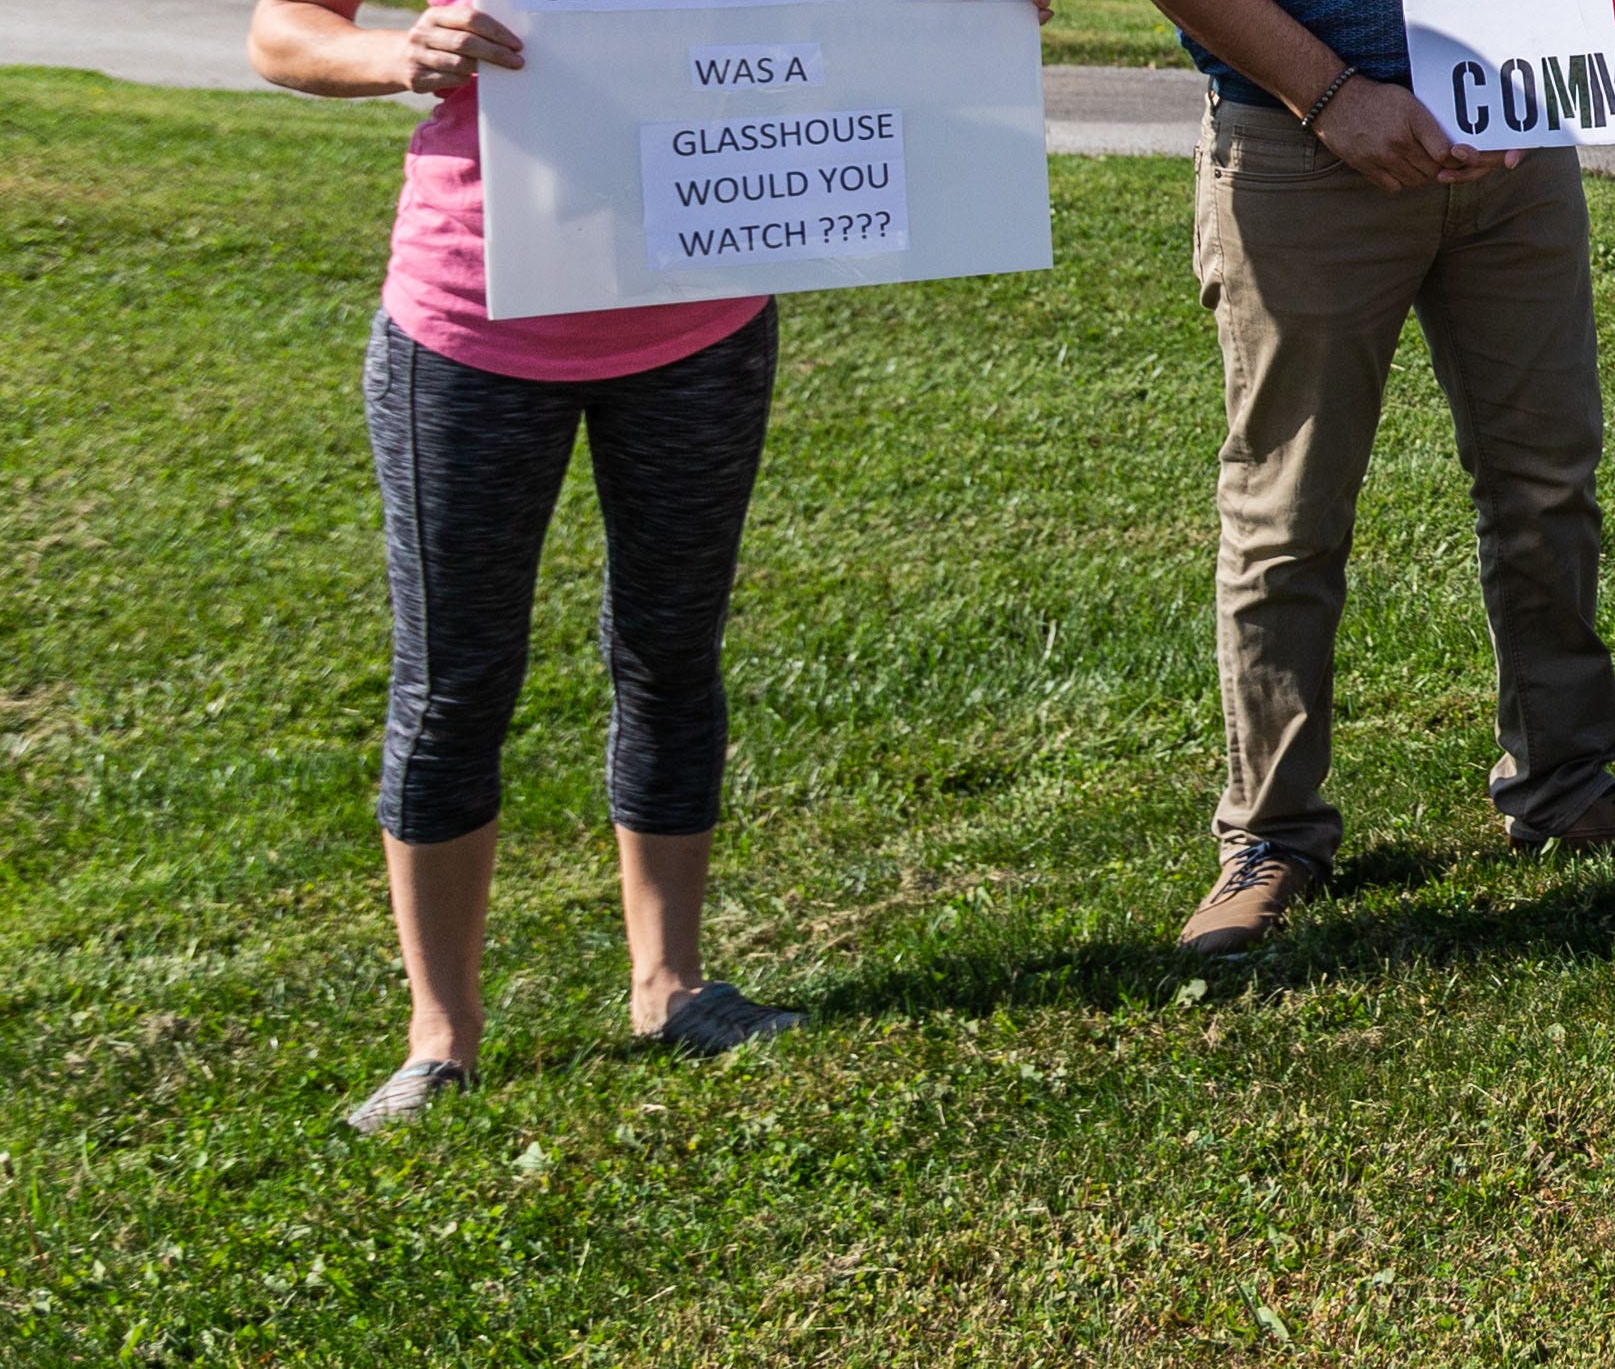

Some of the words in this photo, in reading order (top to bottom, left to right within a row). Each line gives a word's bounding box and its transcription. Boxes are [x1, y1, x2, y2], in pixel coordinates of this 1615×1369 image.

[695, 57, 774, 85] WAS
[784, 56, 807, 82] A
[673, 114, 894, 157] GLASSHOUSE
[675, 171, 809, 207] WOULD
[818, 163, 890, 193] YOU
[679, 220, 807, 257] WATCH
[822, 212, 892, 244] ????
